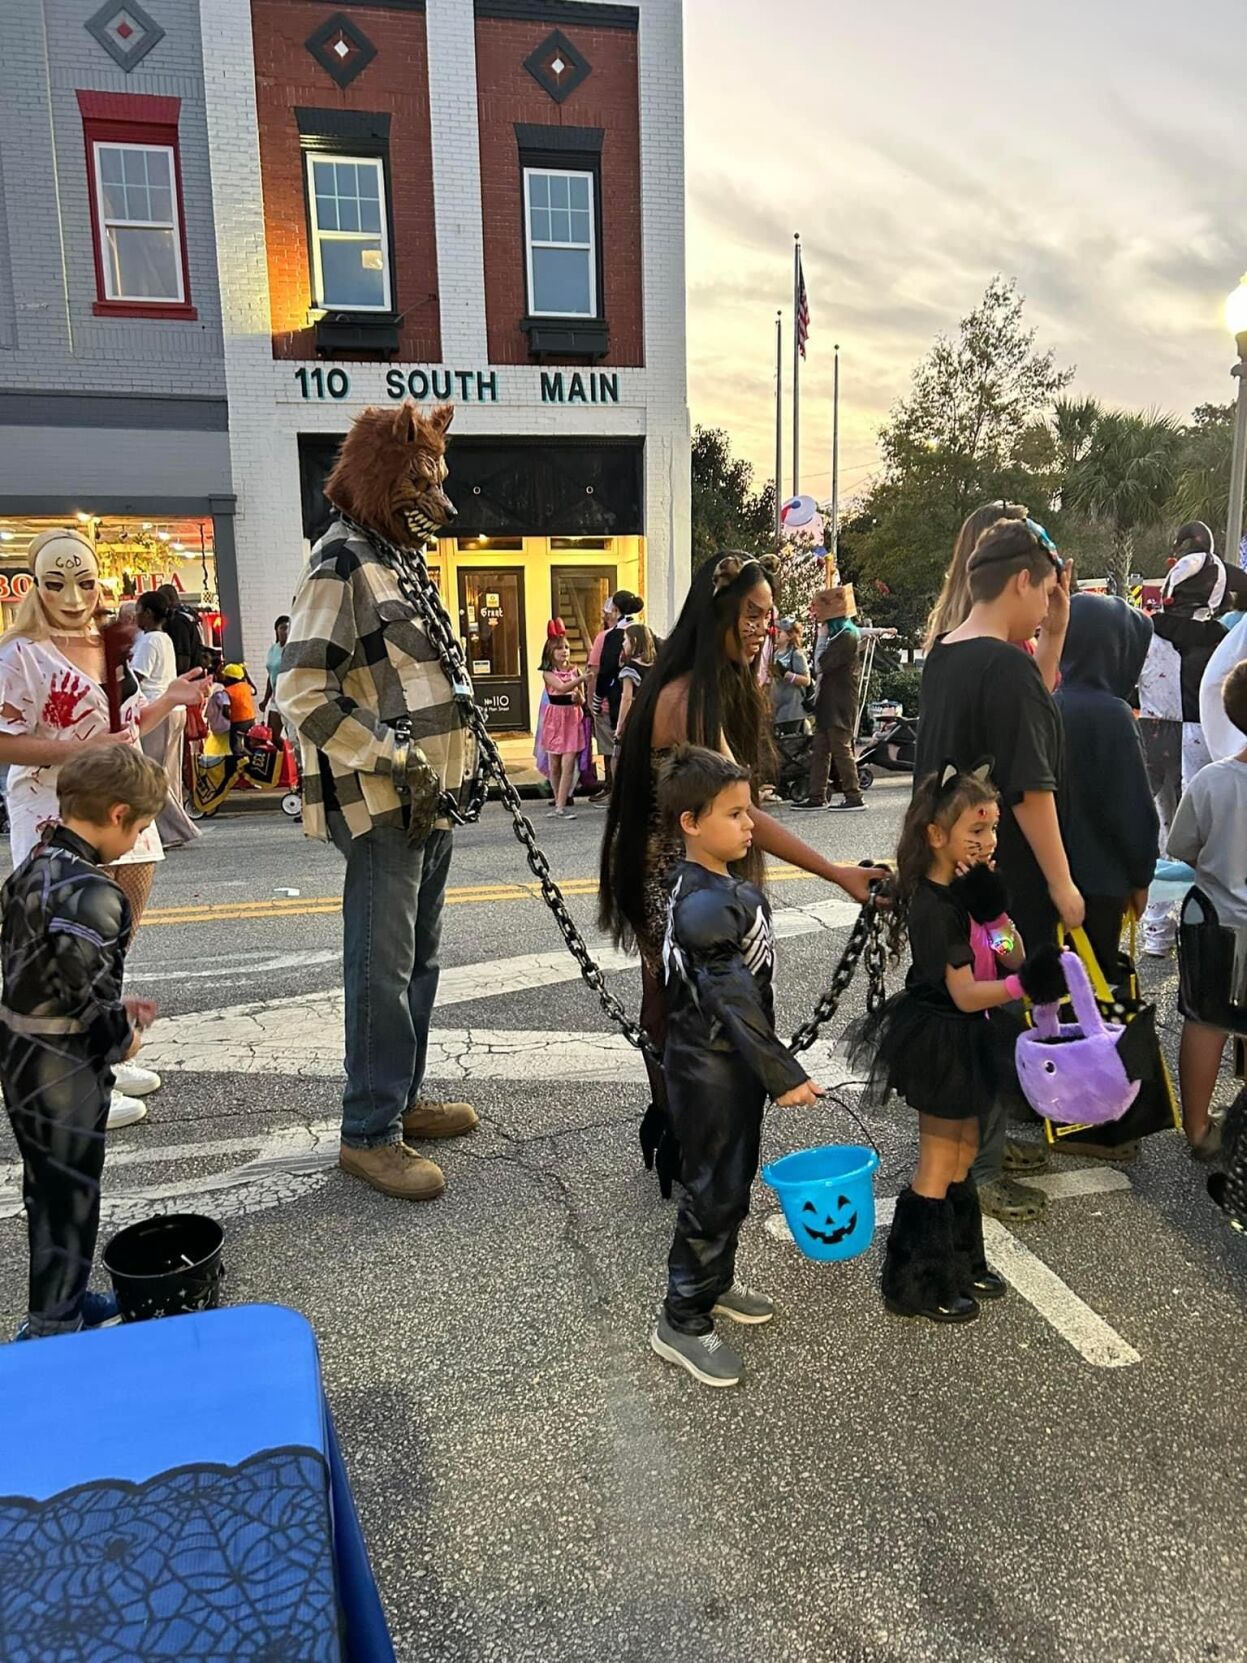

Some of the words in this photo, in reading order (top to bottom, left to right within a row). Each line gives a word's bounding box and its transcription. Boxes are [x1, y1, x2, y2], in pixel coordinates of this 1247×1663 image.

[294, 367, 349, 399] 110
[386, 369, 497, 401] SOUTH
[540, 371, 619, 403] MAIN
[55, 554, 81, 570] GOD
[130, 572, 187, 593] TEA
